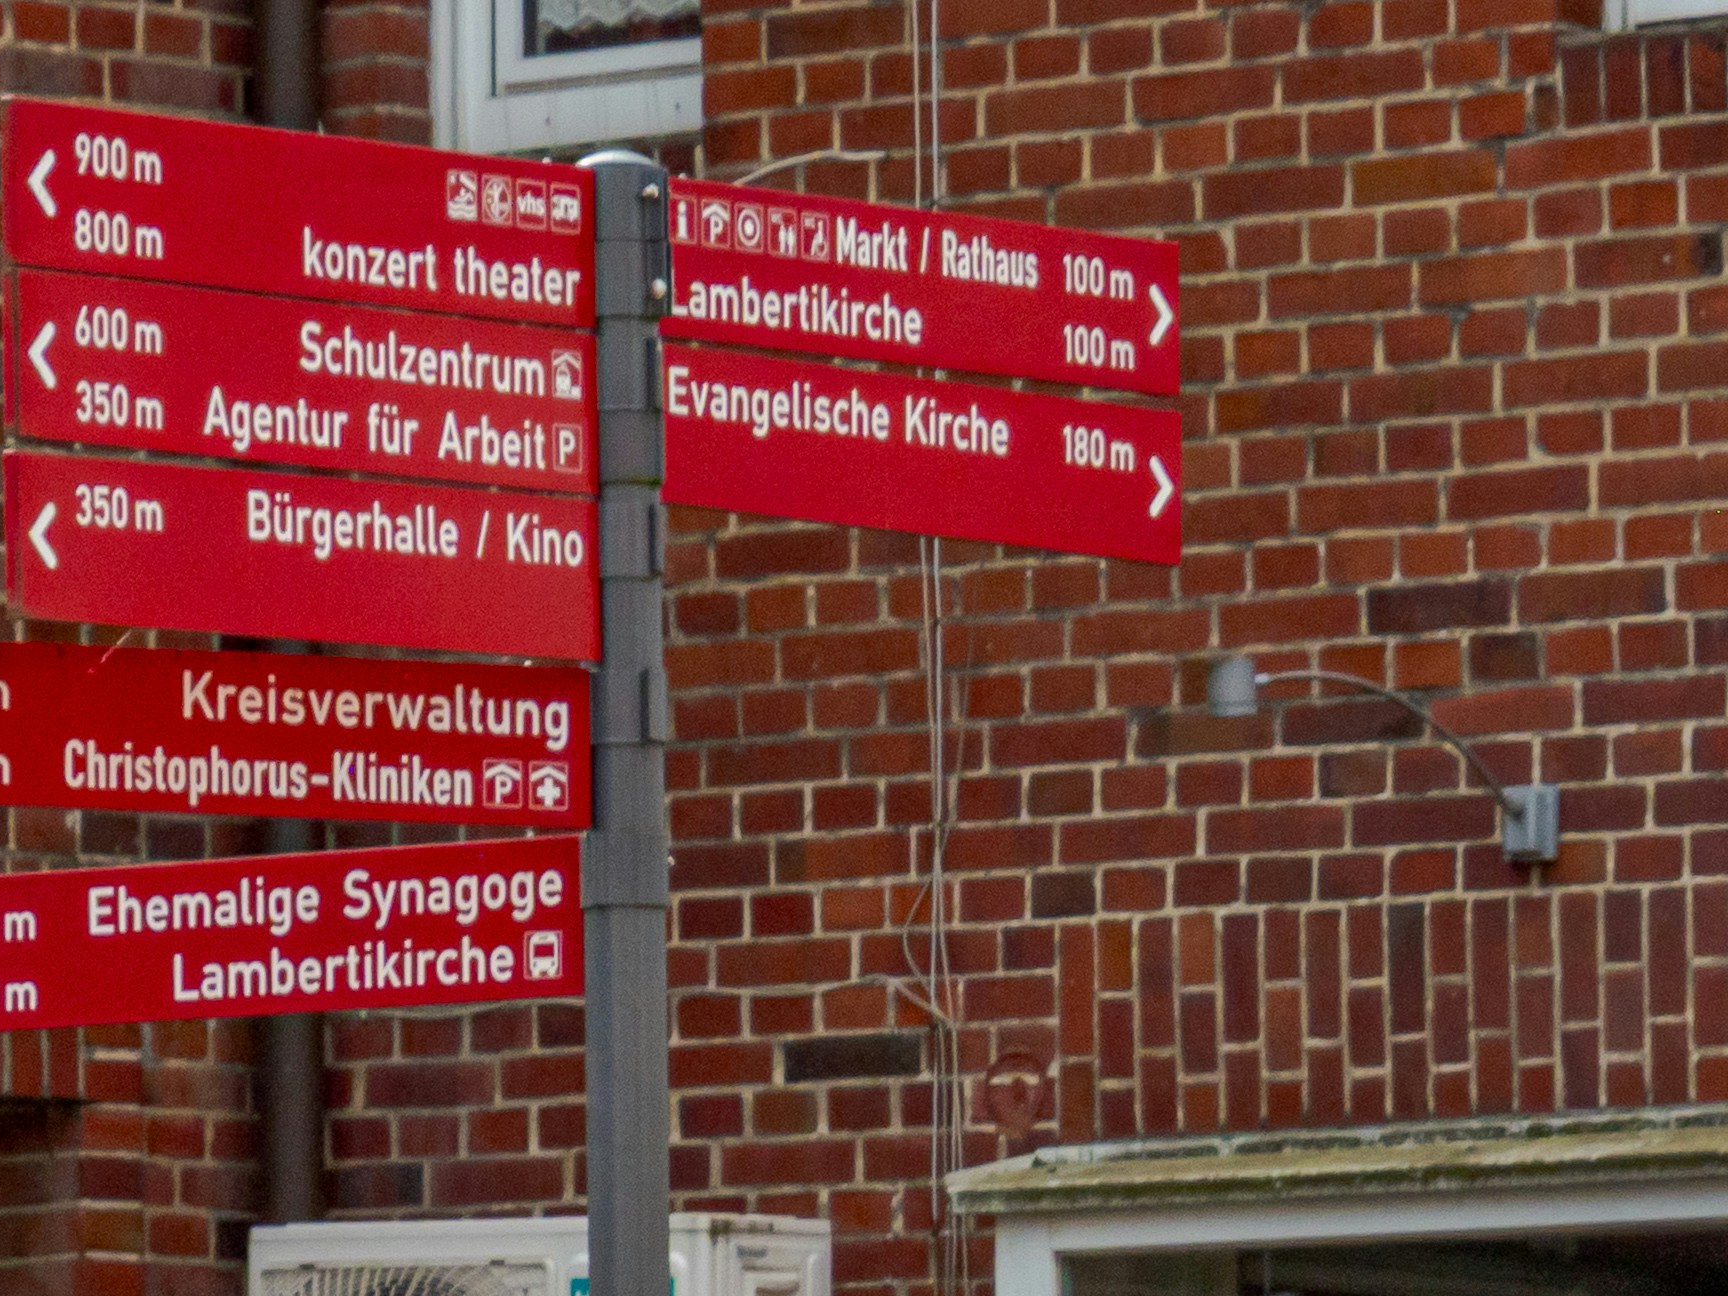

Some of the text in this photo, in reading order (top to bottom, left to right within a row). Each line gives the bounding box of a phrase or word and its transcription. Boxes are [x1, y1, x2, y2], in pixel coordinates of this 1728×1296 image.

[74, 132, 164, 185] 900 m
[74, 209, 164, 260] 800 m
[302, 226, 580, 306] konzert theater
[836, 215, 1039, 289] Markt / Rathaus
[1063, 253, 1135, 301] 100 m
[74, 306, 164, 354] 600 m
[671, 277, 923, 345] Lambertikirche
[300, 321, 545, 397] Schulzentrum
[1063, 325, 1136, 371] 100 m
[75, 382, 164, 430] 350 m
[203, 385, 546, 471] Agentur für Arbeit
[667, 365, 1010, 457] Evangelische Kirche
[1063, 425, 1136, 472] 180 m
[75, 485, 164, 532] 350 m
[247, 490, 585, 567] Bürgerhalle / Kino
[182, 670, 571, 751] Kreisverwaltung
[64, 739, 472, 806] Christophorus-Kliniken
[3, 912, 37, 943] m
[87, 869, 564, 938] Ehemalige Synagoge
[4, 982, 39, 1013] m
[172, 939, 514, 1005] Lambertikirche
